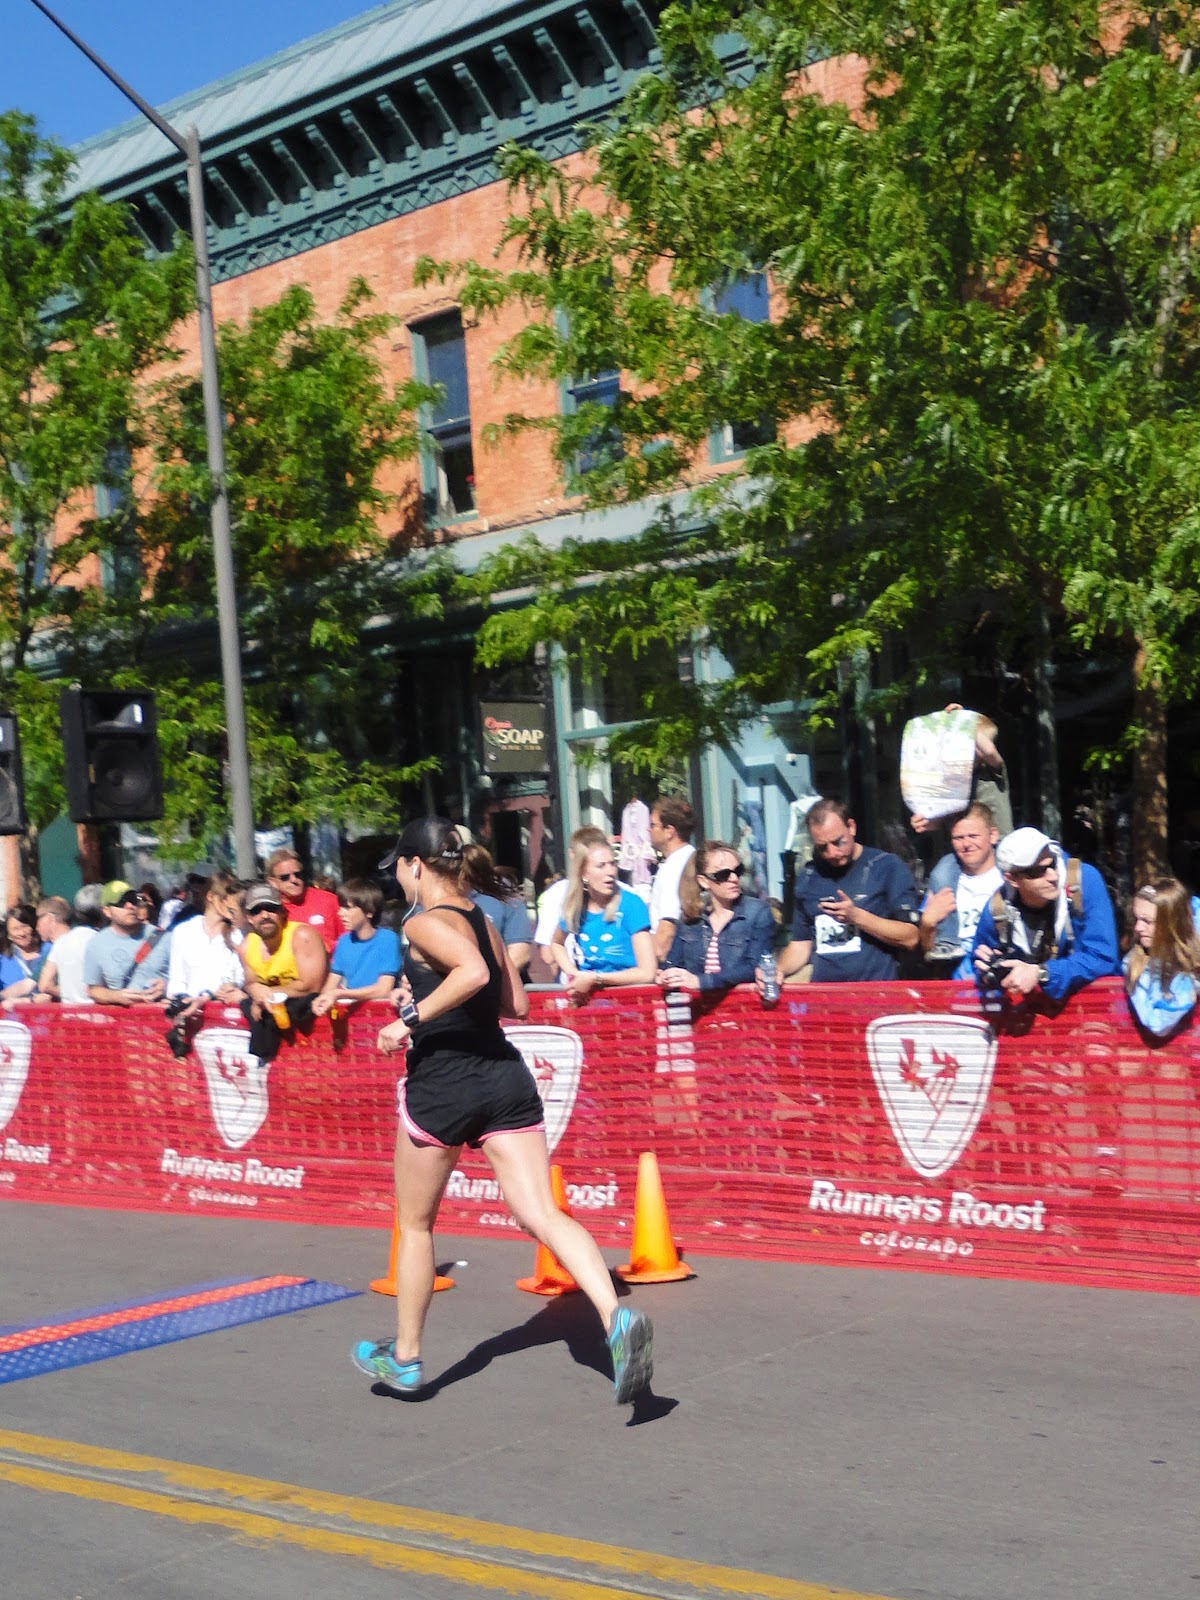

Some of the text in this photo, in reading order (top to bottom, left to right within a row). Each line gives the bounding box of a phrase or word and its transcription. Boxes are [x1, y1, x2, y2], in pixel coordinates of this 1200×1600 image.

[498, 729, 544, 745] SOAP
[160, 1148, 306, 1188] Runners Roost
[565, 1179, 619, 1207] oost
[808, 1179, 1047, 1232] Runners Roost
[859, 1231, 974, 1256] COLORADO
